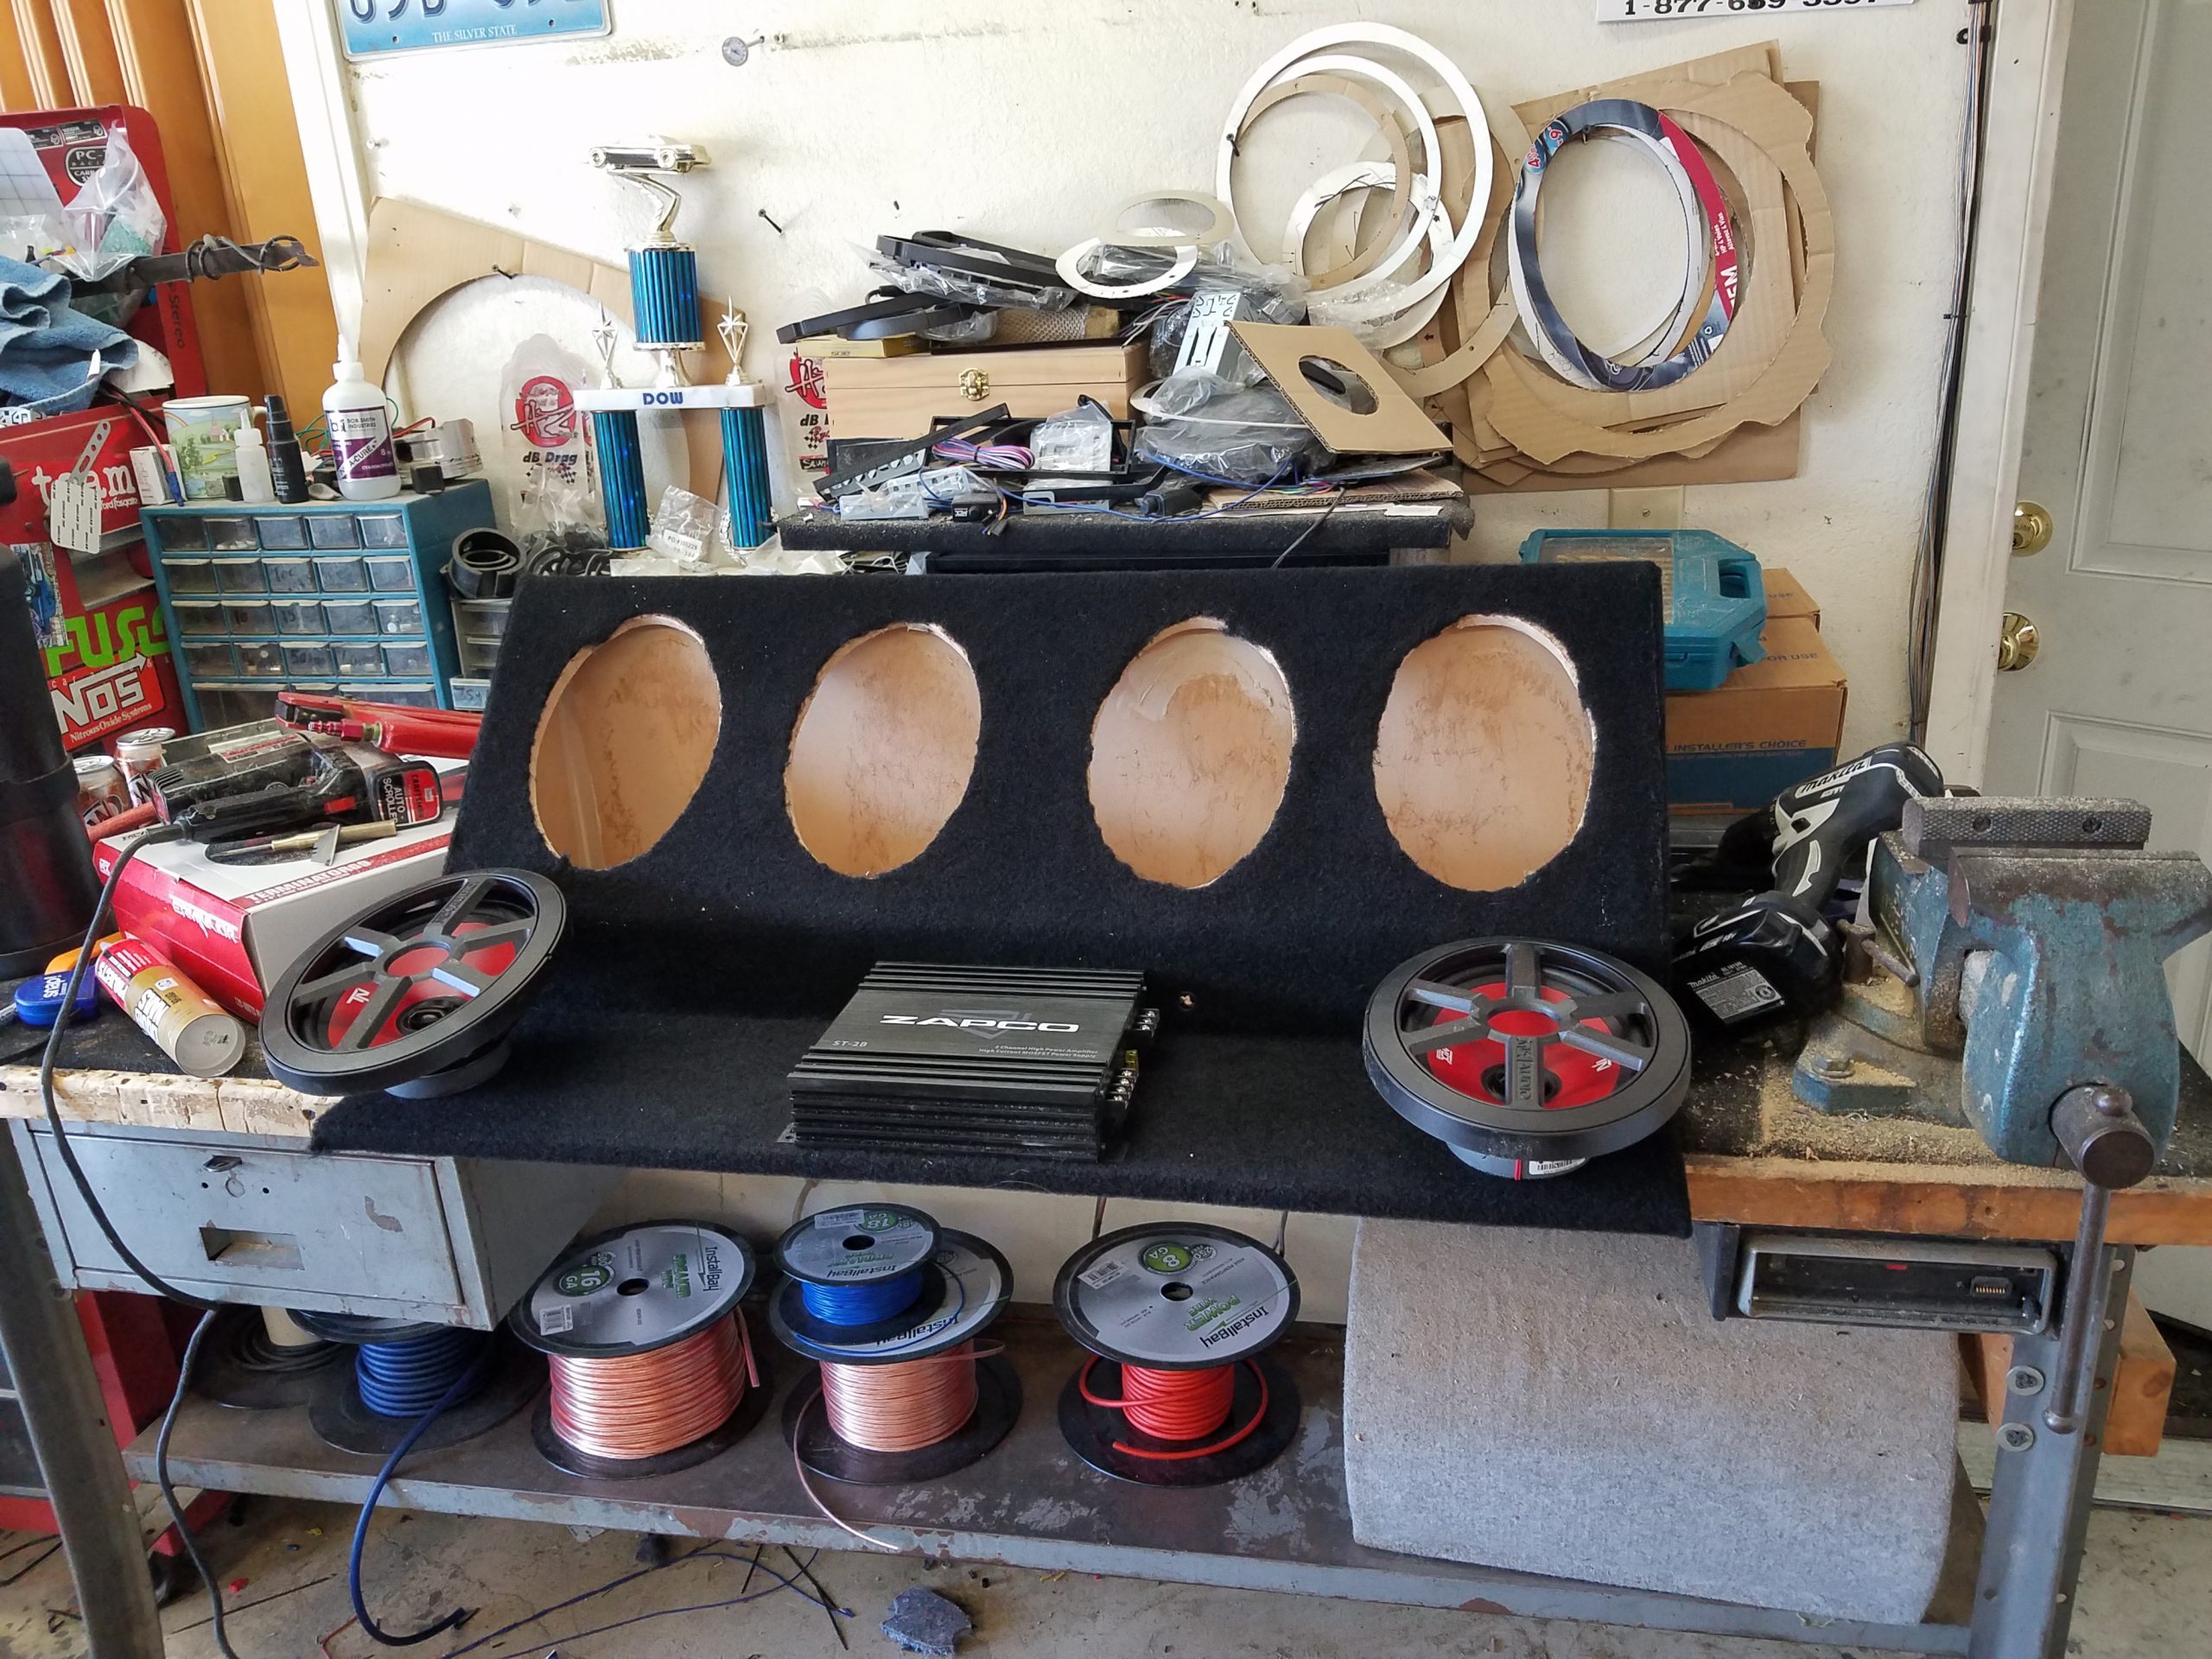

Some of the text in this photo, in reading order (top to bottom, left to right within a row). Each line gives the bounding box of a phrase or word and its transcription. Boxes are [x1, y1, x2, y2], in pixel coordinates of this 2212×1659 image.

[431, 24, 518, 42] THE SILVER STATE
[642, 391, 683, 405] DOW
[523, 451, 578, 466] dB Drag
[31, 466, 137, 507] tam
[50, 669, 146, 734] NOS
[69, 702, 153, 743] Nitrous Oxide Systems
[1673, 740, 1807, 751] INSTALLER'S CHOICE
[393, 787, 405, 813] AUTO
[880, 1014, 1079, 1033] ZAPCO
[866, 1218, 891, 1228] 18
[1148, 1247, 1169, 1259] GA
[1163, 1254, 1180, 1268] 8
[702, 1247, 720, 1292] InstallBay
[827, 1264, 898, 1278] InstallBay
[566, 1275, 578, 1289] GA
[580, 1270, 601, 1287] 16
[1184, 1294, 1242, 1332] POWER
[1199, 1306, 1269, 1349] InstallBay
